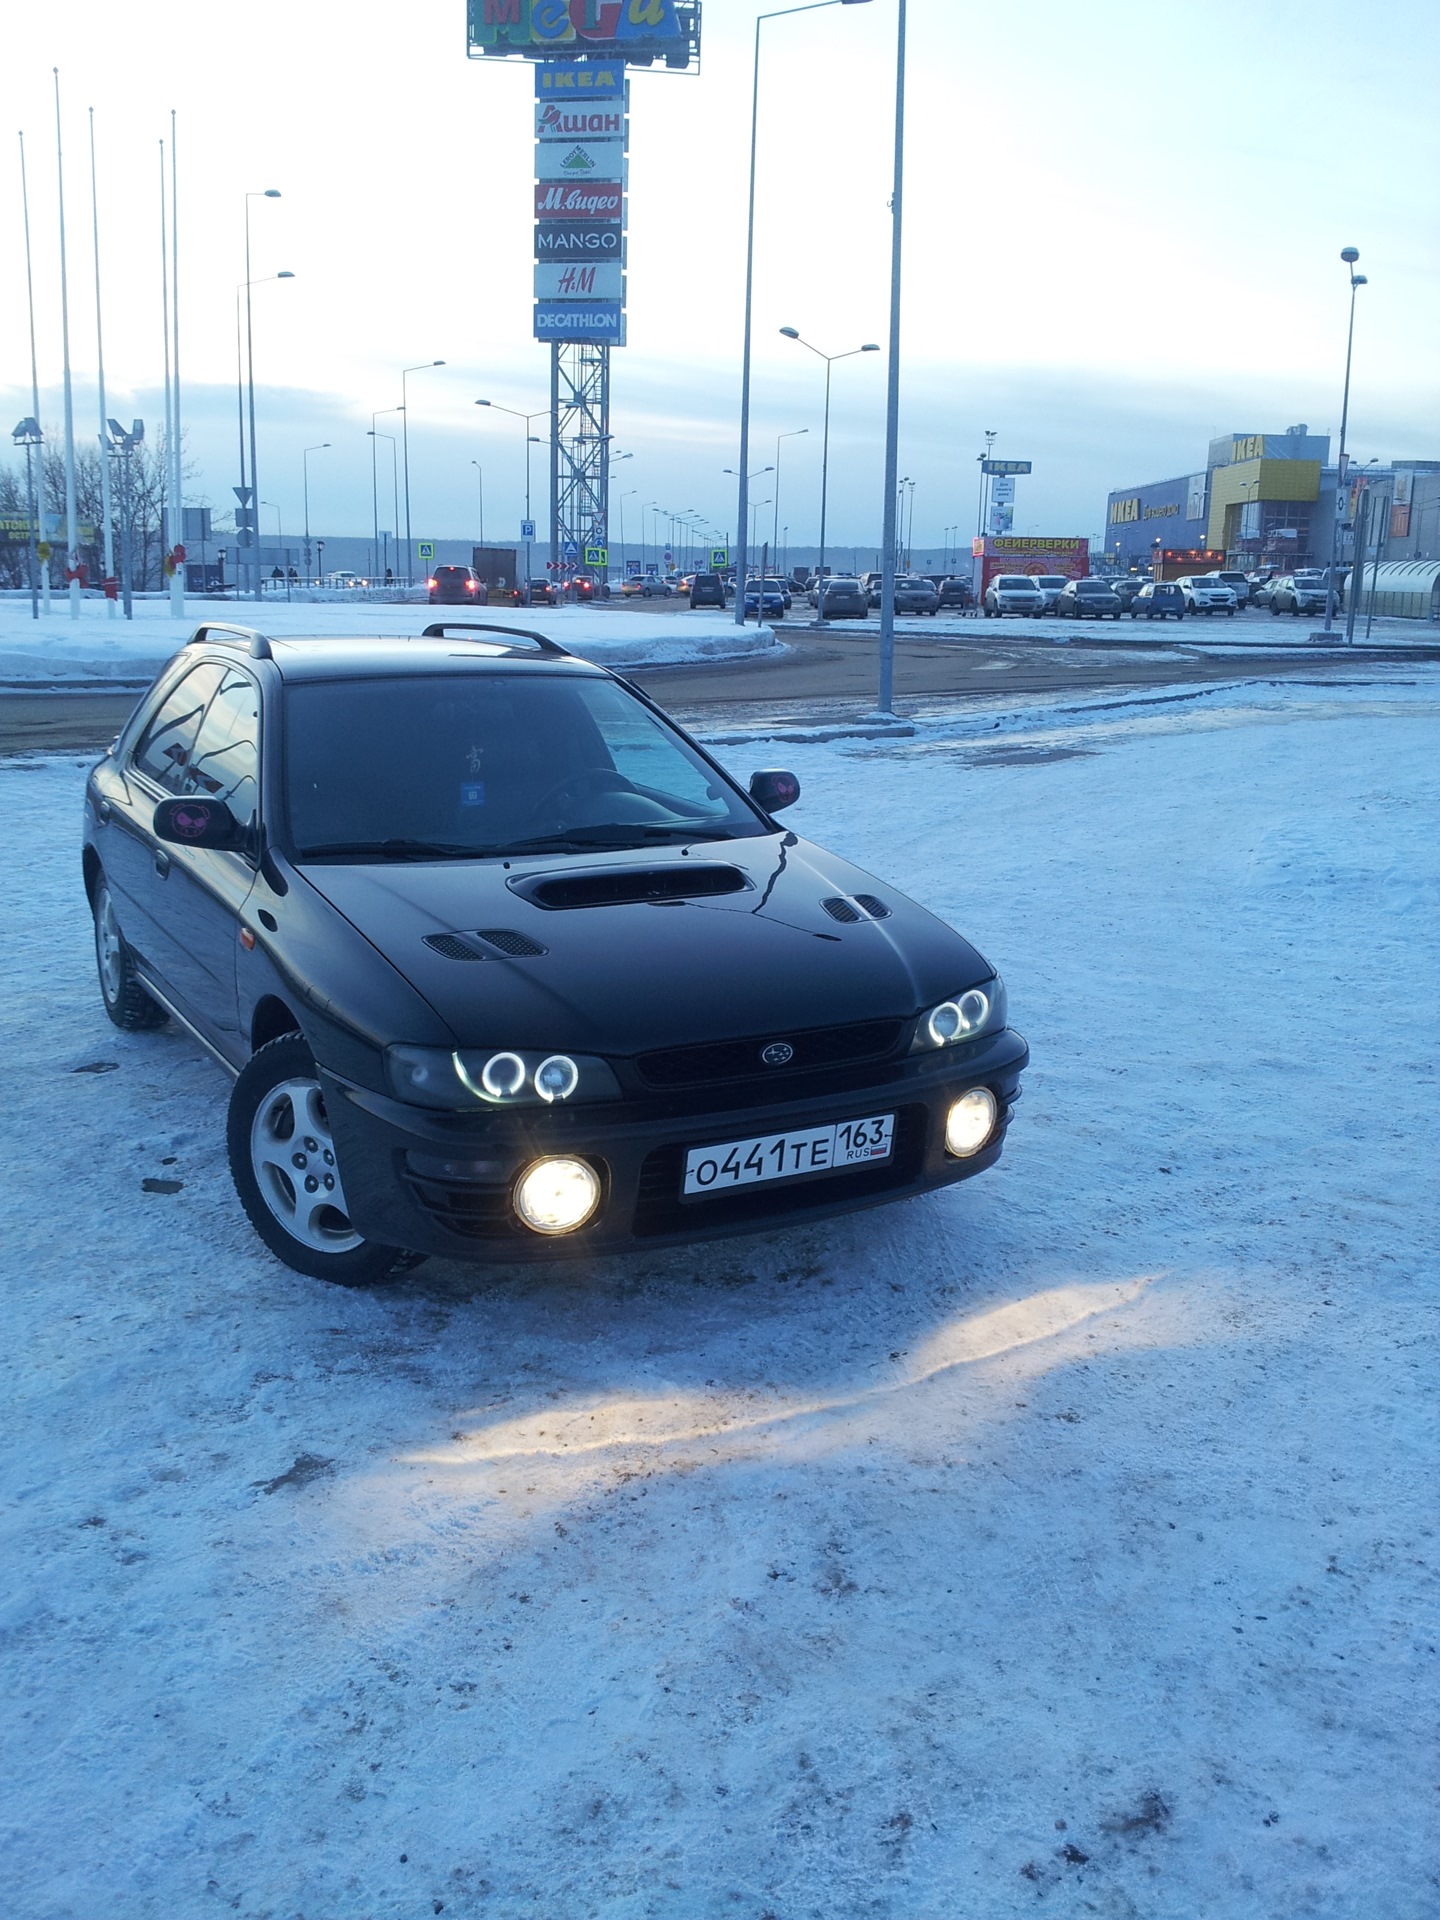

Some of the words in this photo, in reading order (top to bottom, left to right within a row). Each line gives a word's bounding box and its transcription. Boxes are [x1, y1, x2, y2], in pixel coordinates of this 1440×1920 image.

[542, 71, 616, 88] IKEA
[560, 149, 577, 168] LEROY
[575, 144, 597, 168] MERLIN
[538, 233, 617, 249] MANGO
[558, 266, 597, 294] H&M
[537, 313, 617, 328] DECATHLON
[1232, 434, 1265, 462] IKEA
[988, 462, 1029, 473] IKEA
[1110, 498, 1139, 524] ИКЕА
[839, 1119, 885, 1151] 163
[846, 1147, 870, 1161] RUS
